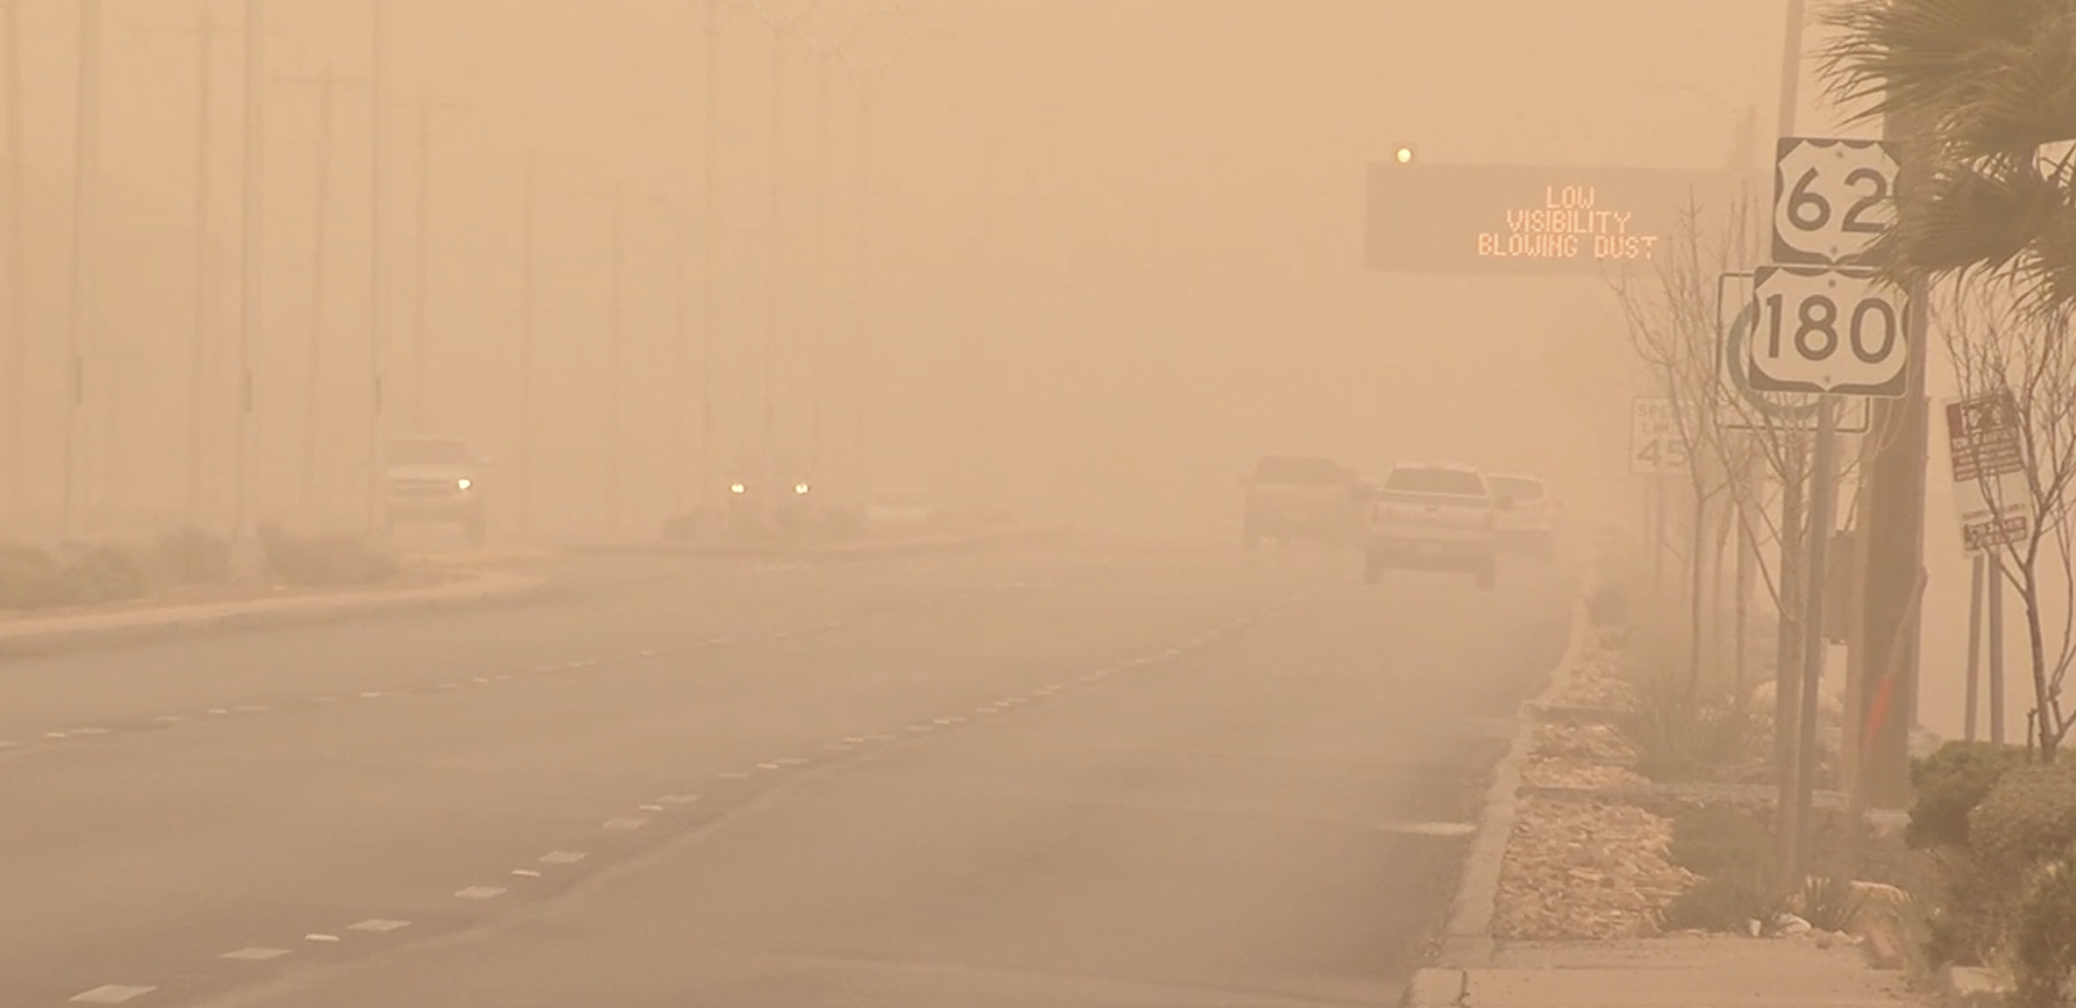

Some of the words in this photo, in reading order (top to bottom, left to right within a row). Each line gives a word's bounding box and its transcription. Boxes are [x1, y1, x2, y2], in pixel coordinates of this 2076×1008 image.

[1546, 186, 1595, 209] LOW
[1787, 166, 1889, 233] 62
[1506, 209, 1632, 234] VISIBILITY
[1477, 233, 1578, 258] BLOWING
[1593, 235, 1658, 259] DUST
[1766, 293, 1896, 364] 180
[1636, 438, 1689, 467] 45
